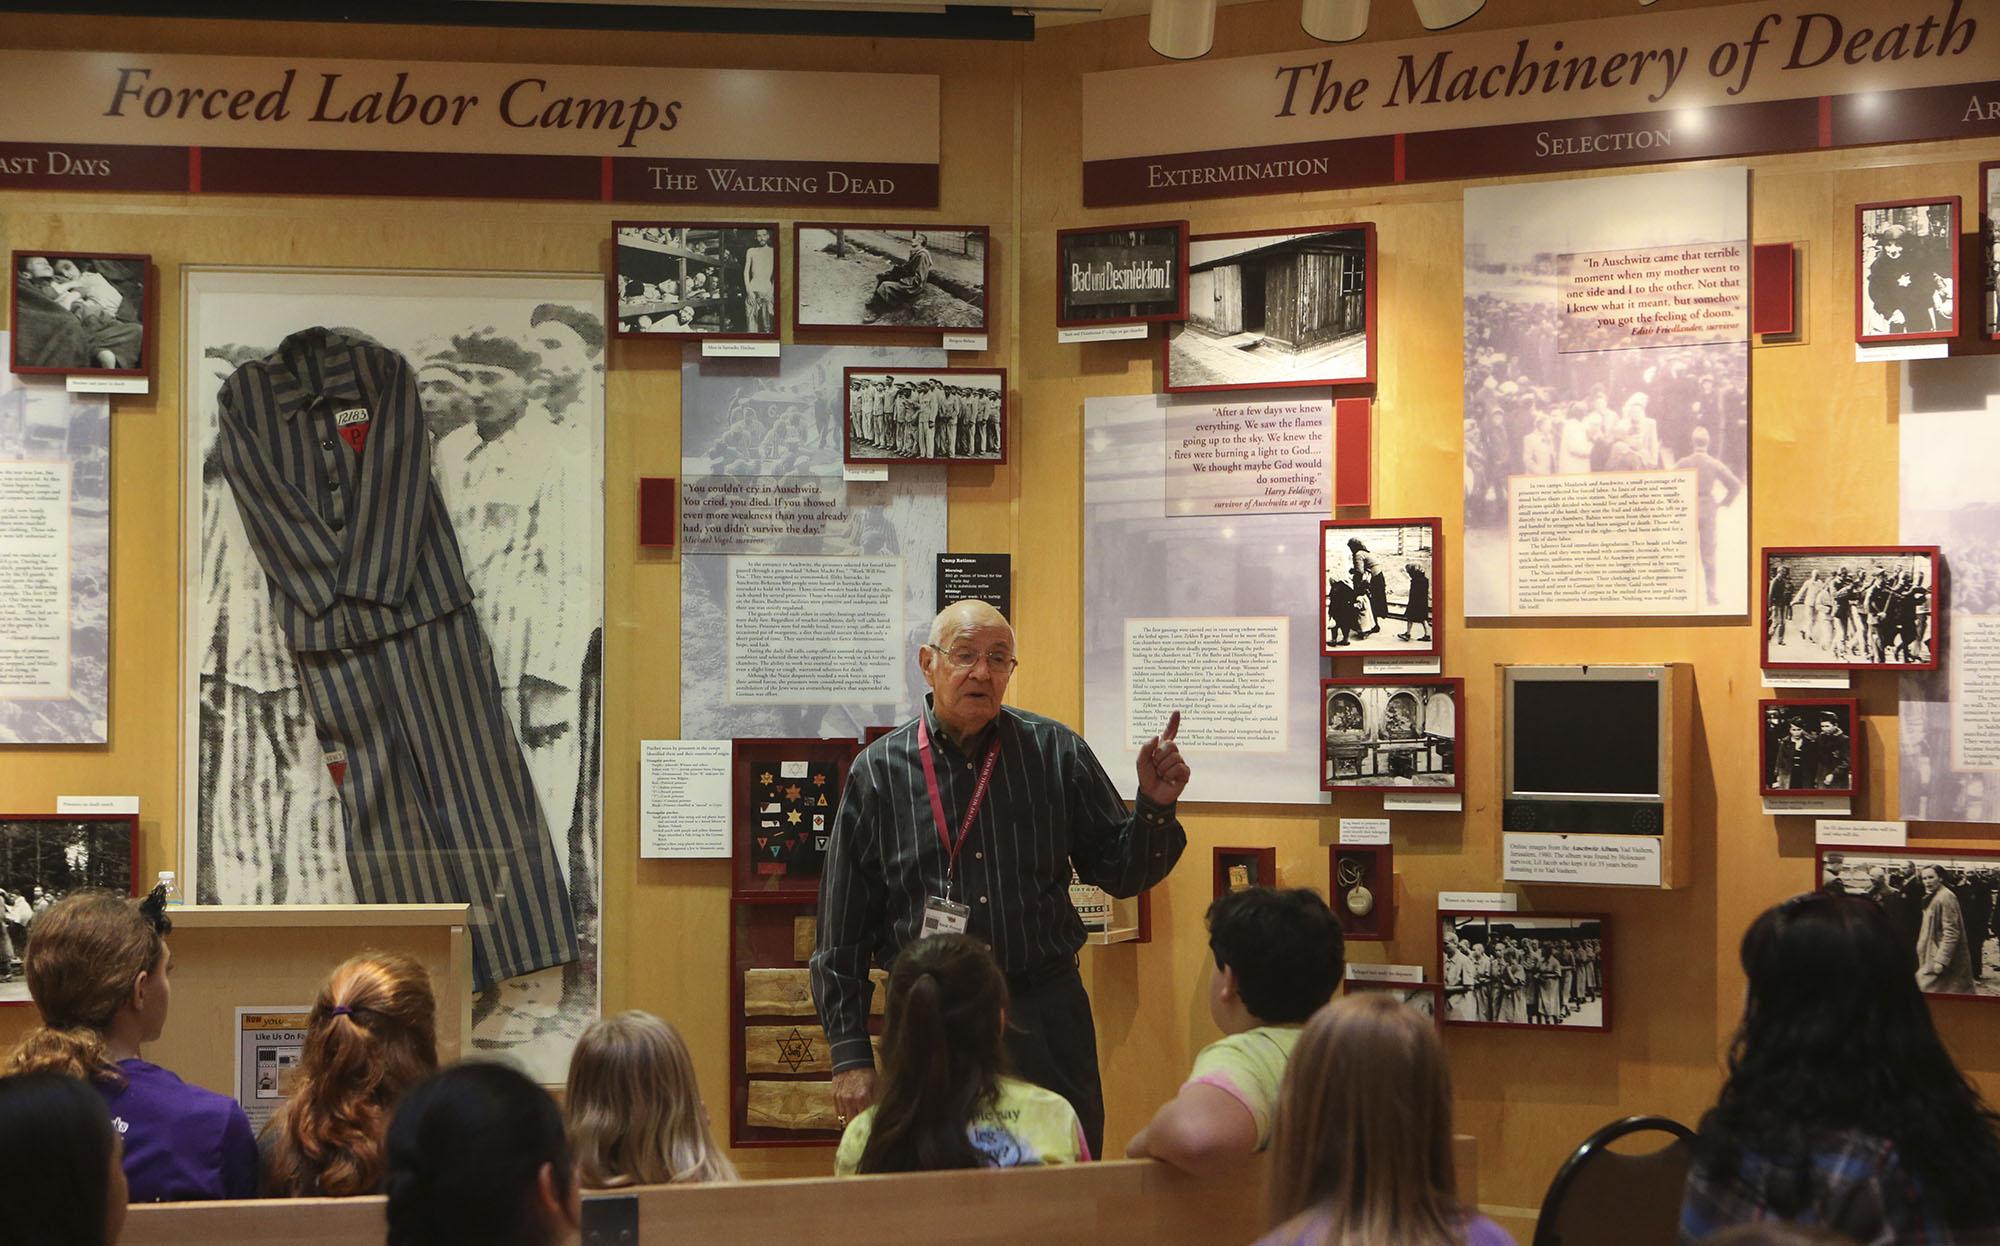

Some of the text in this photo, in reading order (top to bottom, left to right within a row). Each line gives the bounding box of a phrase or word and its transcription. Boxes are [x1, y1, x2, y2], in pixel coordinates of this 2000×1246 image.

[1275, 0, 1977, 118] The Machinery of Death
[102, 67, 683, 148] Forced Labor Camps
[1535, 129, 1672, 158] SELECTION
[47, 151, 111, 176] DAYS
[1147, 157, 1330, 188] EXTERMINATION
[648, 167, 895, 195] THE WALKING DEAD
[1583, 246, 1739, 267] "In Auschwitz came that terrible
[1072, 263, 1091, 292] Bad
[1091, 265, 1105, 291] und
[1574, 262, 1740, 283] moment when my mother went to
[1566, 275, 1739, 298] one side and I to the other. Not that
[1566, 300, 1570, 312] I
[1573, 299, 1598, 312] knew
[1601, 297, 1624, 310] what
[1627, 298, 1634, 308] it
[1673, 293, 1690, 305] but
[1693, 290, 1738, 304] somehow
[1597, 316, 1615, 328] you
[1618, 313, 1633, 326] got
[1636, 310, 1652, 322] the
[1655, 308, 1687, 323] feeling
[1690, 307, 1700, 319] of
[1212, 405, 1237, 416] "After
[1246, 404, 1262, 415] few
[1263, 404, 1282, 417] days
[1299, 402, 1322, 413] knew
[1195, 419, 1241, 434] everything.
[1244, 419, 1258, 429] We
[1278, 418, 1292, 428] the
[1294, 417, 1322, 428] flames
[350, 428, 361, 445] P
[1182, 430, 1322, 448] going up to the sky. We knew the
[1174, 448, 1191, 459] fires
[1214, 447, 1248, 461] burning
[1258, 446, 1277, 460] light
[1280, 447, 1289, 456] to
[1192, 457, 1322, 474] We thought maybe God would
[1256, 472, 1322, 486] do something."
[683, 482, 822, 496] "You couldn't cry in Auschwitz.
[1264, 485, 1286, 498] Harry
[683, 495, 700, 506] You
[729, 499, 746, 509] you
[748, 496, 772, 506] died.
[774, 496, 784, 506] If
[783, 500, 800, 510] you
[803, 496, 836, 507] showed
[1214, 499, 1242, 508] survivor
[1252, 496, 1288, 507] Auschwitz
[1298, 499, 1311, 509] age
[731, 509, 772, 520] weakness
[774, 510, 795, 520] than
[797, 513, 814, 523] you
[816, 510, 848, 523] already
[682, 522, 824, 536] had, you didn't survive the day."
